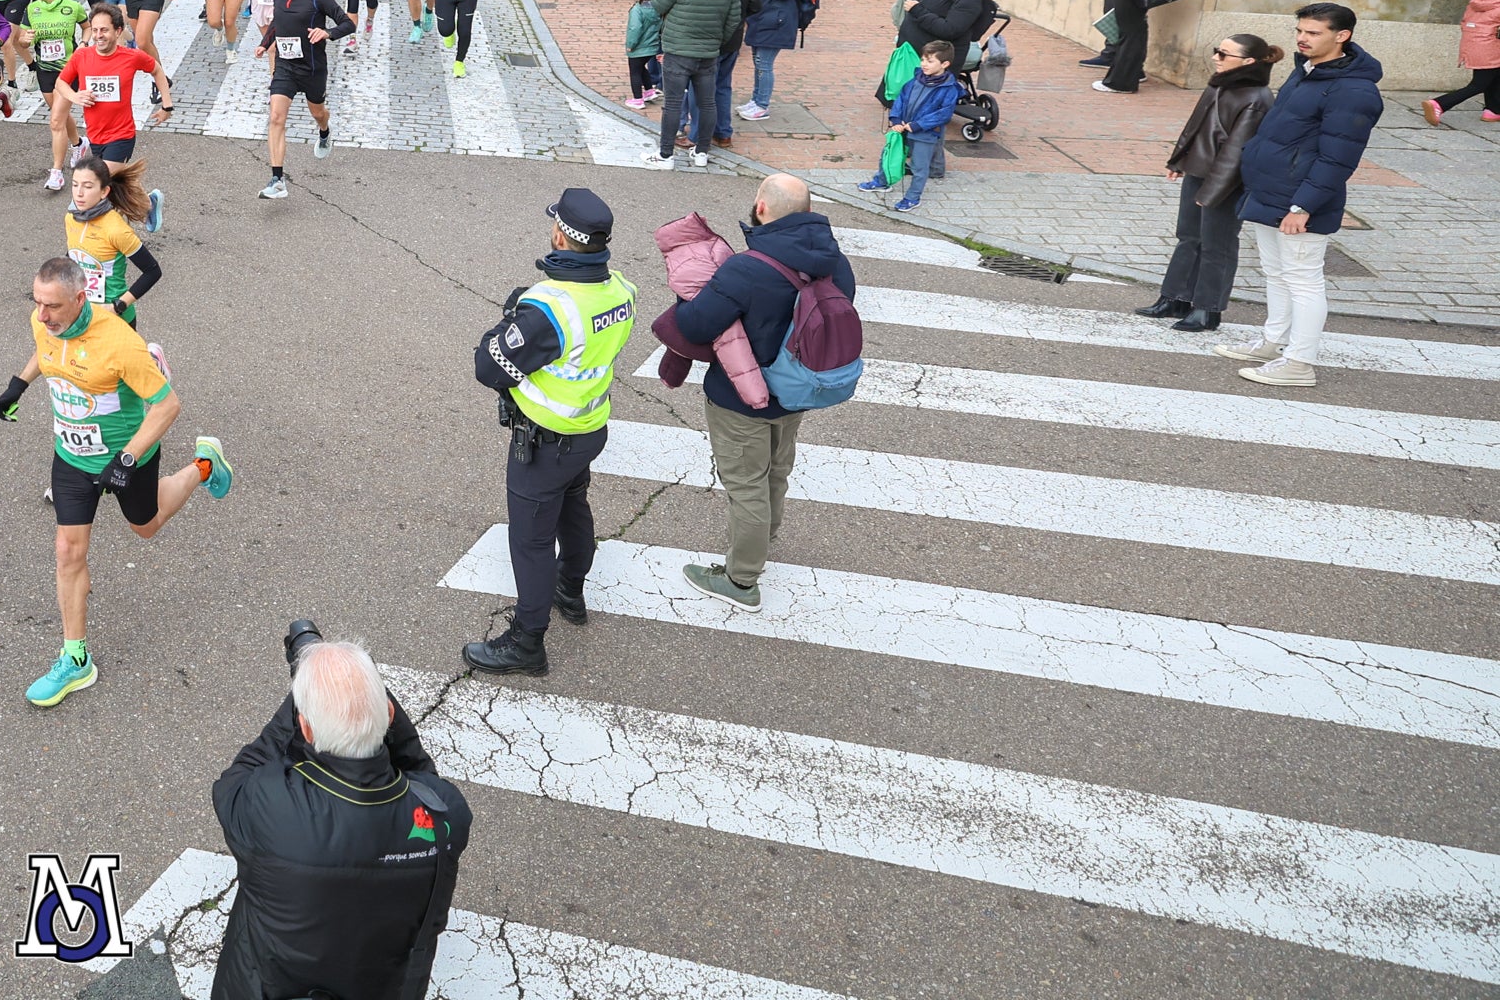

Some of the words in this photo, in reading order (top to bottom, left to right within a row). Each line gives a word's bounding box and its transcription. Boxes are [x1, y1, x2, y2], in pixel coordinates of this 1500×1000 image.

[43, 44, 61, 53] 110
[282, 42, 294, 51] 97
[91, 82, 115, 92] 285
[51, 387, 90, 409] ALCER
[61, 430, 94, 447] 101
[409, 850, 427, 860] somos
